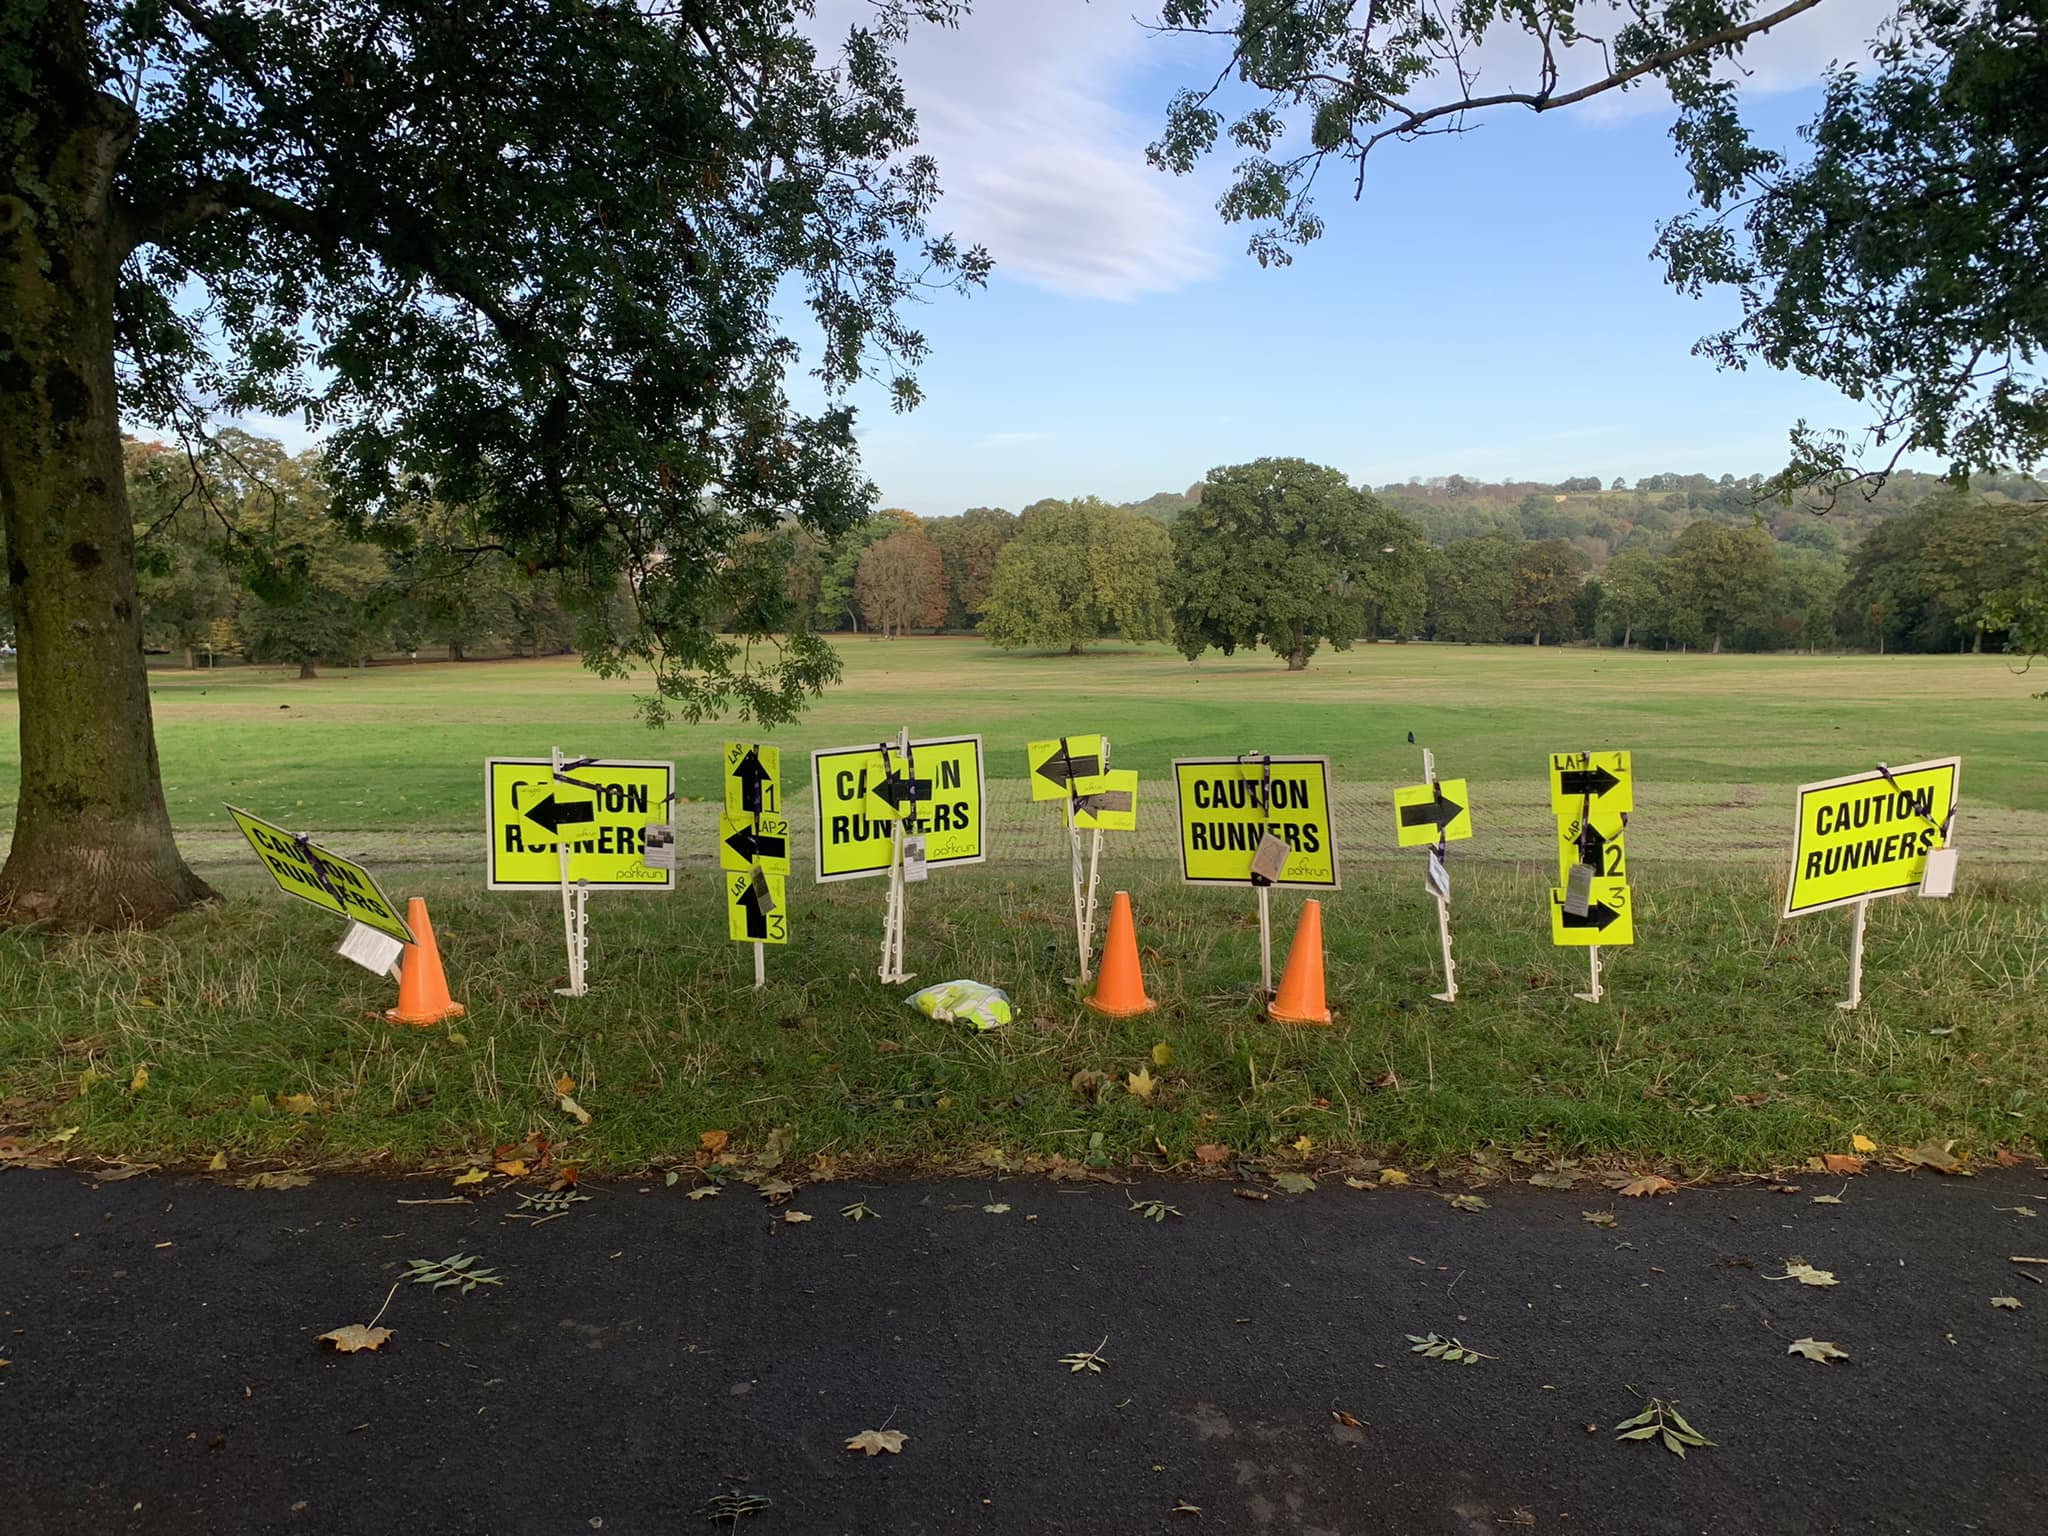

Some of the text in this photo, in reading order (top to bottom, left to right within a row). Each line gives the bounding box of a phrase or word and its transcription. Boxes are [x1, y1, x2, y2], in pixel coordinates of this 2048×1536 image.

[728, 744, 743, 764] LAP
[1613, 752, 1626, 772] 1
[765, 784, 779, 814] 1
[1816, 786, 1935, 836] CAUTION
[762, 821, 776, 833] AP
[1563, 820, 1580, 841] LAP
[1605, 844, 1624, 877] 2
[1805, 827, 1935, 881] RUNNERS
[616, 868, 663, 880] parkrun
[731, 876, 746, 896] LAP
[1609, 887, 1626, 908] 3
[769, 914, 785, 940] 3
